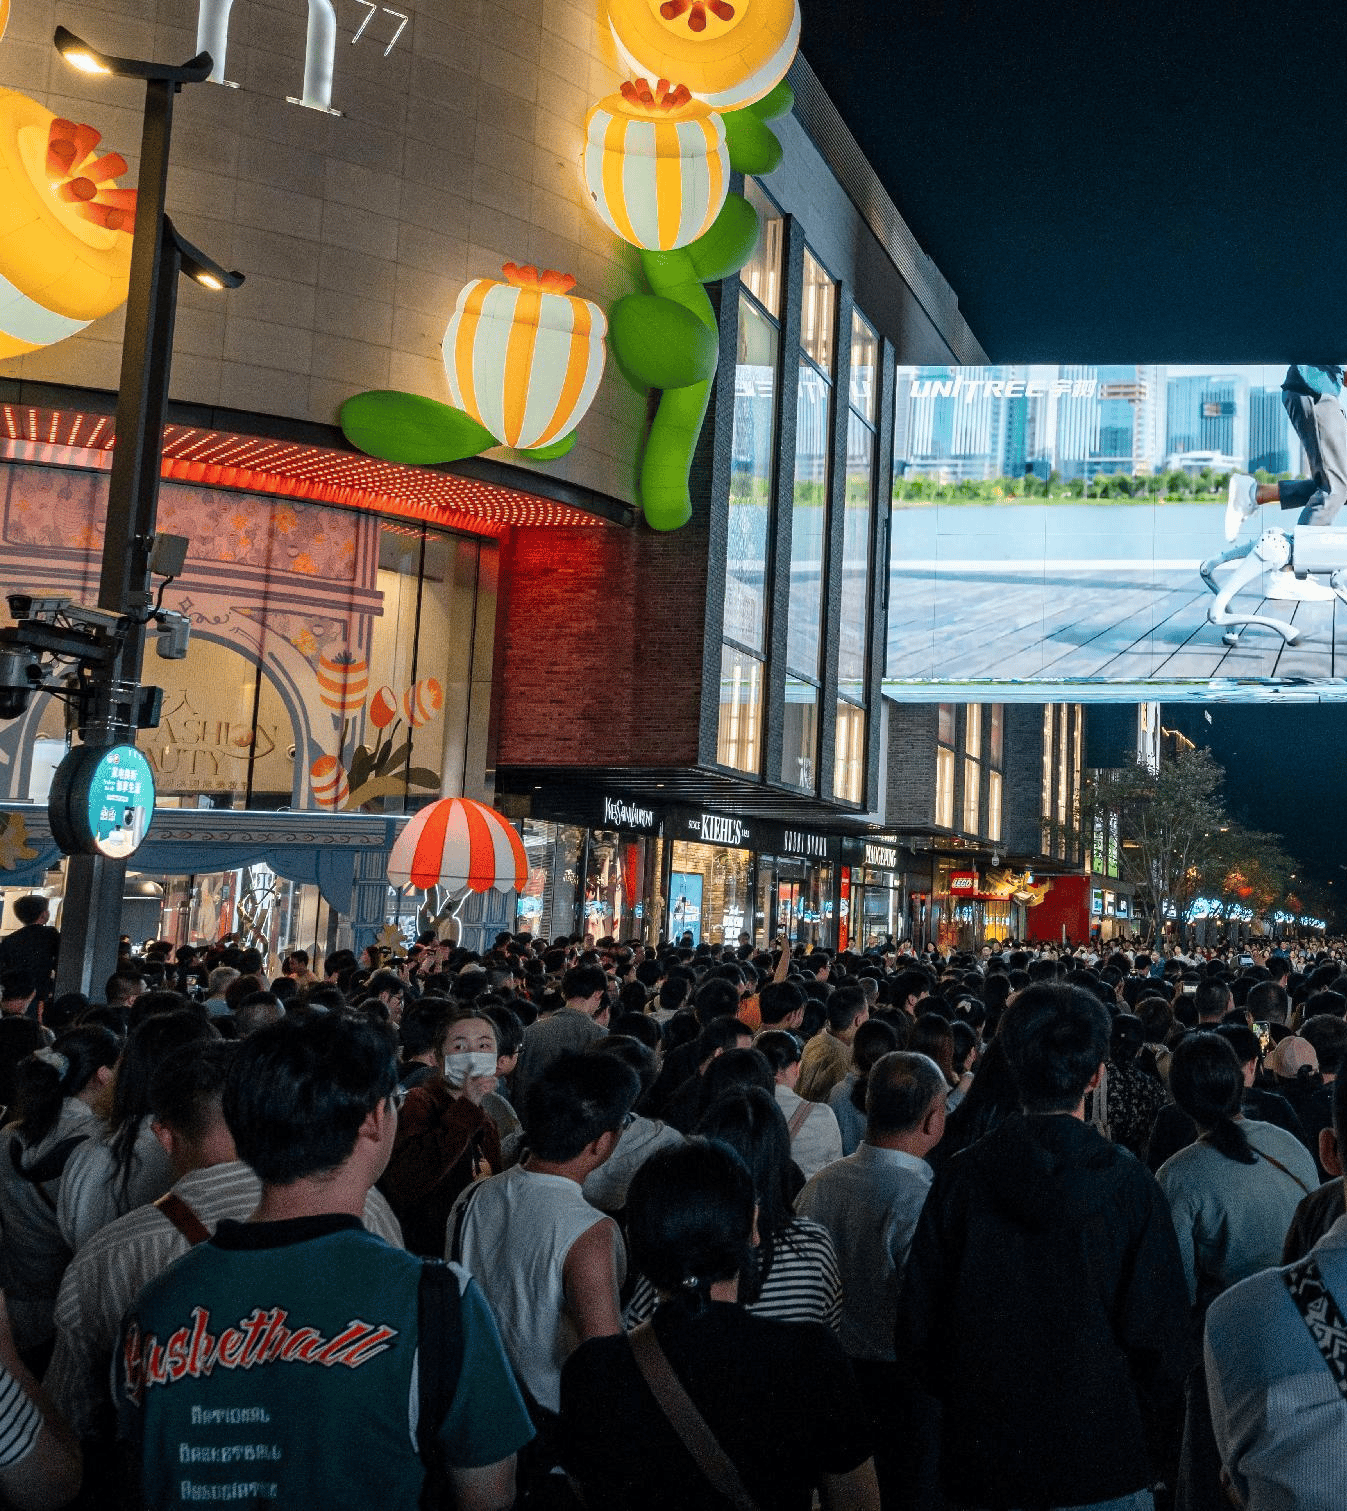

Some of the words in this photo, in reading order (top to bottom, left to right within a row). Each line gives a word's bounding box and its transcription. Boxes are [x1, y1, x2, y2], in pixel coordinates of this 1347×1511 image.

[910, 375, 1045, 404] UNITREE
[701, 814, 742, 845] KIEHL'S
[953, 879, 972, 888] LEGO
[123, 1306, 399, 1406] Basketball
[191, 1404, 271, 1425] NATIONAL
[179, 1443, 283, 1464] BASKETBALL
